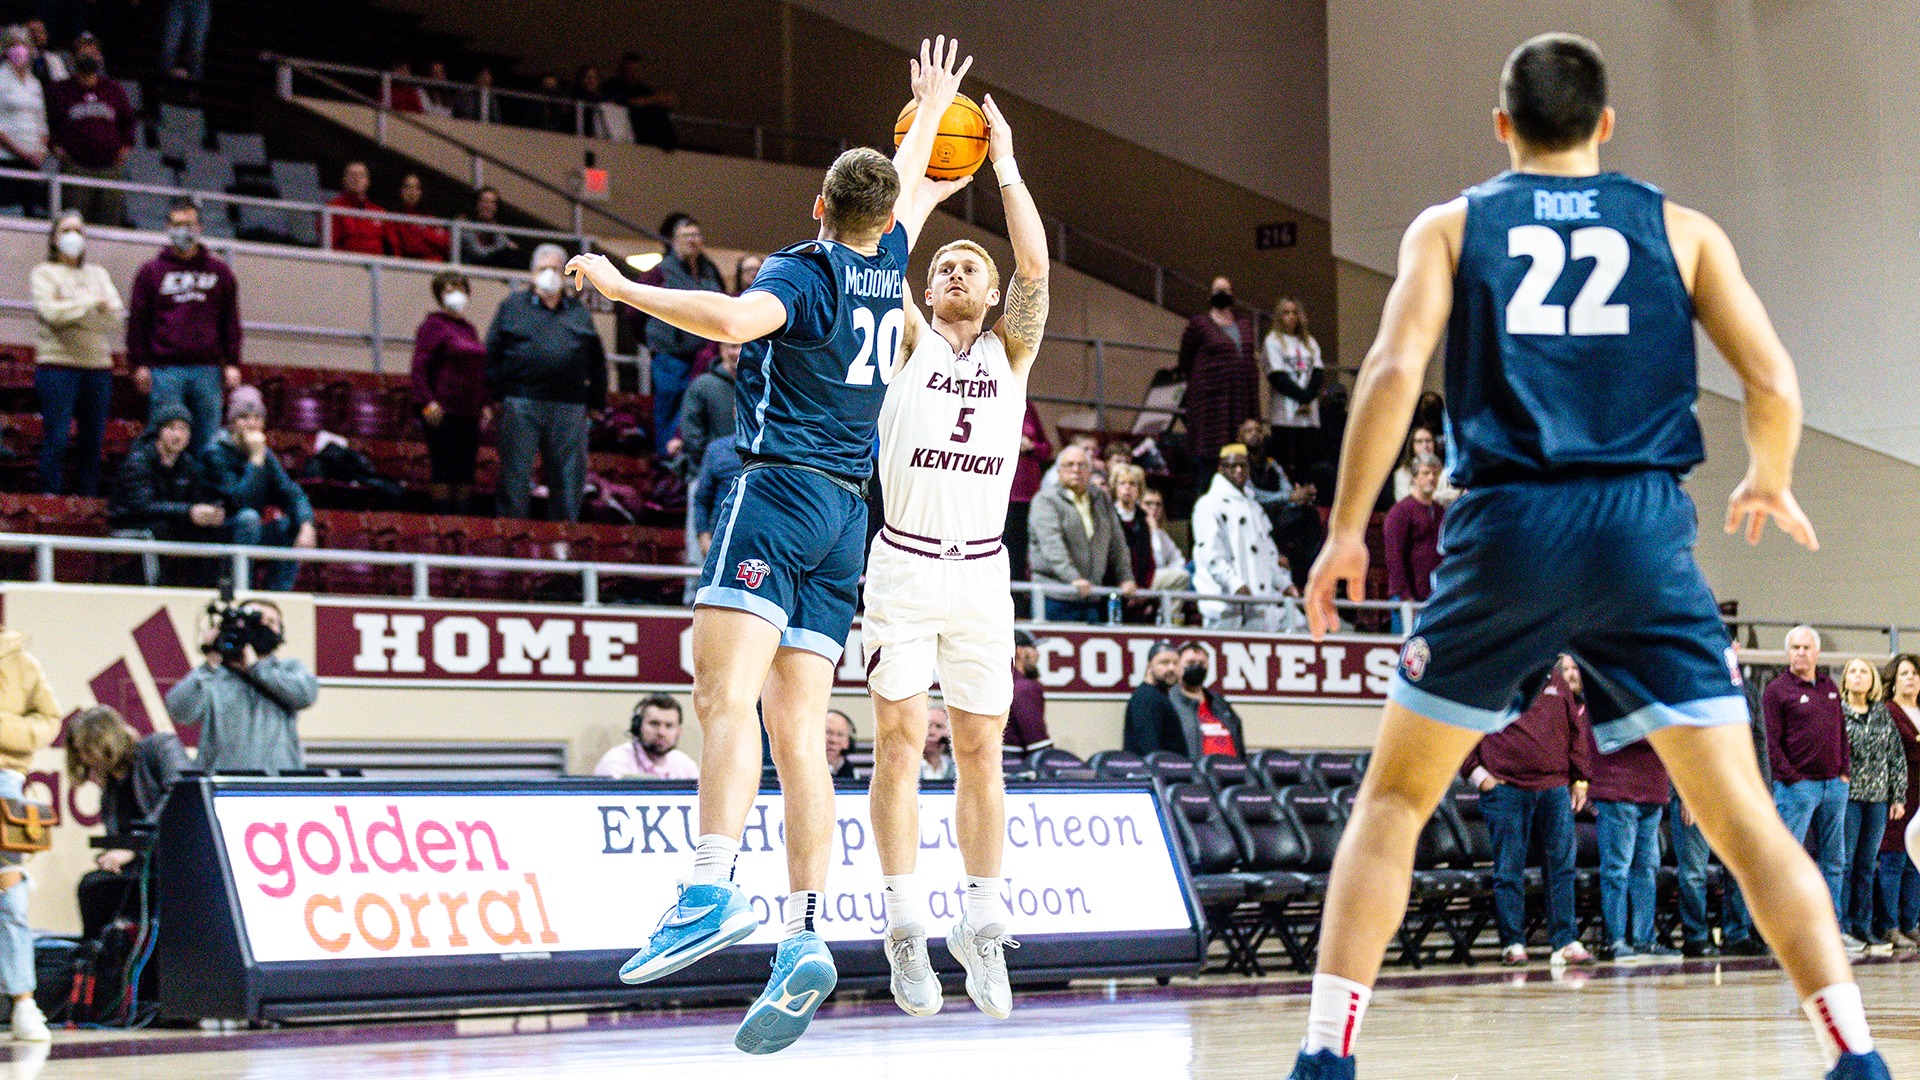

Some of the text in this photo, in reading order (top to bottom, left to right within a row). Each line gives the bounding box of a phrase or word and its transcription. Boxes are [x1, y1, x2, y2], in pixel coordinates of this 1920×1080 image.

[1533, 188, 1600, 221] RODE
[1505, 224, 1631, 336] 22
[844, 306, 905, 386] 20
[926, 371, 998, 399] EASTERN
[909, 447, 1005, 476] KENTUCKY
[949, 407, 976, 444] 5
[353, 612, 639, 677] HOME
[1038, 636, 1400, 694] COLNELS
[244, 804, 510, 899] golden
[303, 872, 561, 954] corral
